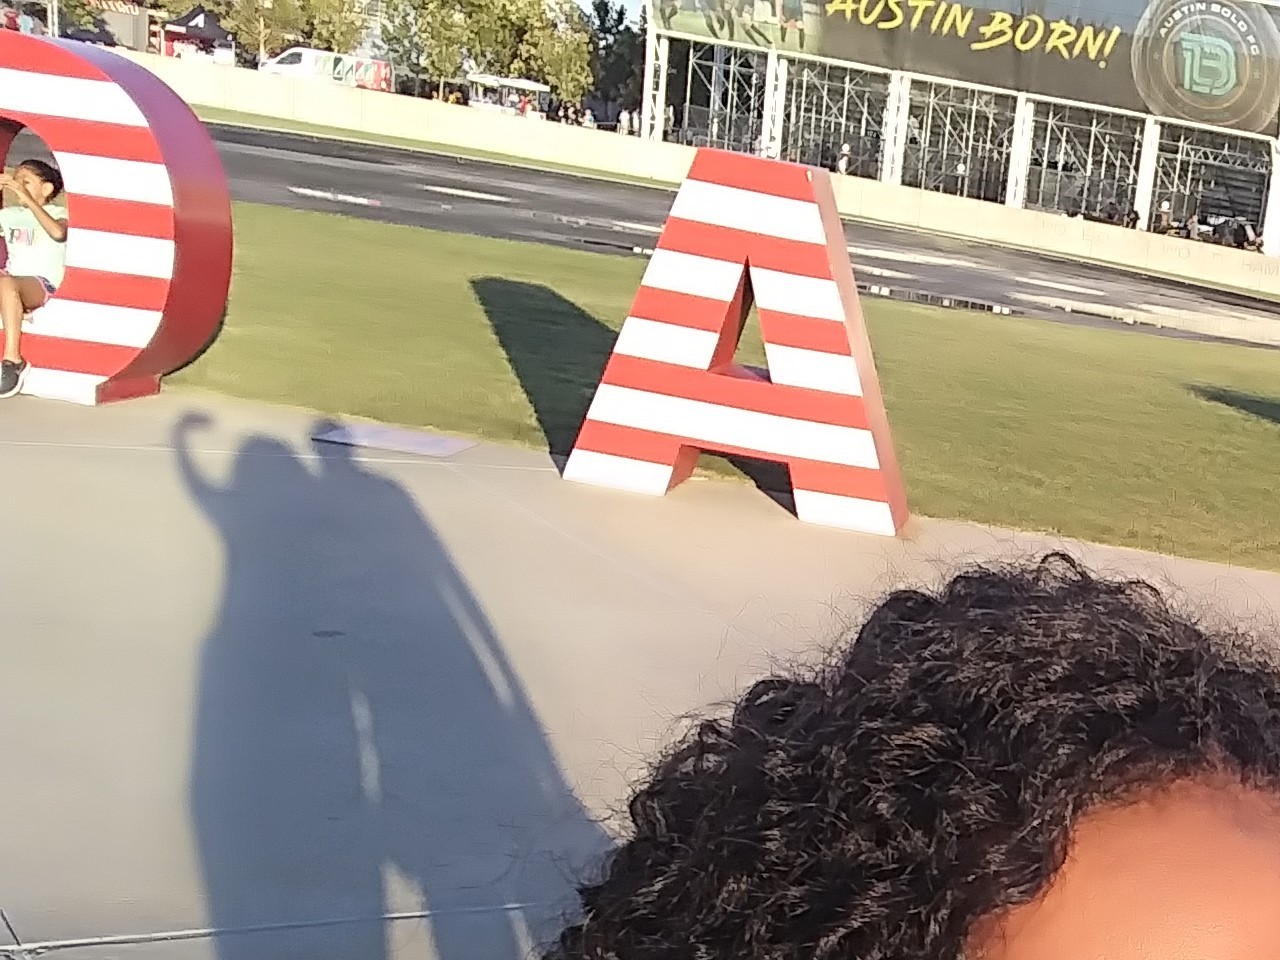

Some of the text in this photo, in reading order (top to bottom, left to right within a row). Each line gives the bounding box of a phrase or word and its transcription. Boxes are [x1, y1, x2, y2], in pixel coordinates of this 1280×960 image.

[826, 0, 1121, 69] AUSTIN BORN!
[1159, 2, 1260, 56] AUSTIN BOLD FC
